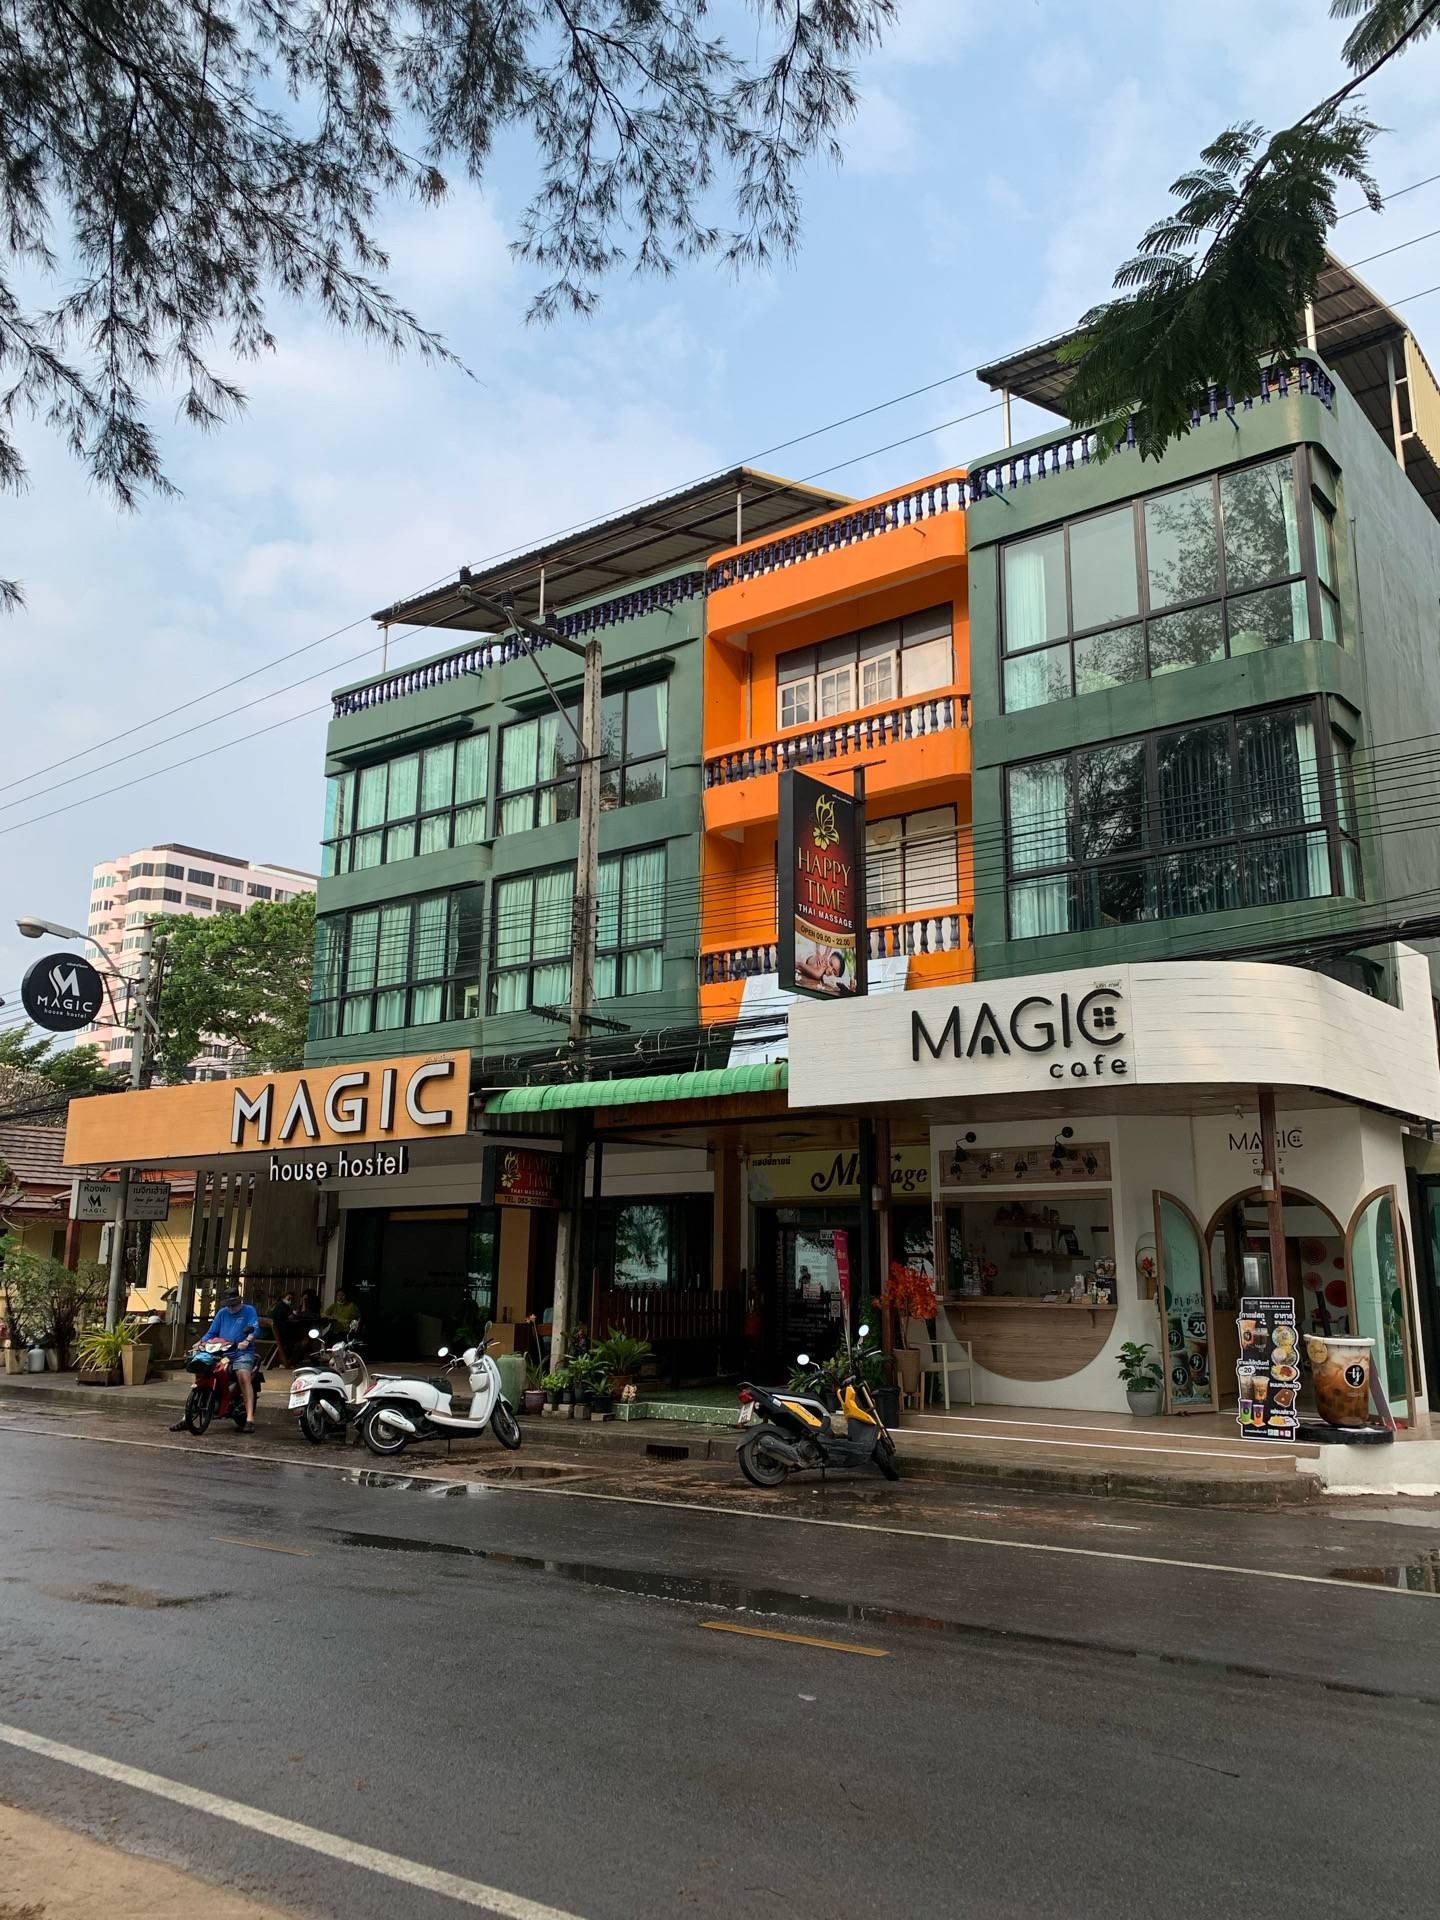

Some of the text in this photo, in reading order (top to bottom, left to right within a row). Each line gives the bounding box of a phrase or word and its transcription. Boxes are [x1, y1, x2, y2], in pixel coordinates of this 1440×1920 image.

[798, 847, 852, 888] HAPPY
[805, 878, 846, 914] TIME
[798, 903, 853, 929] THAI MASSAGE
[800, 925, 816, 937] OPEN
[816, 932, 832, 944] 09.00
[836, 937, 851, 947] 22.00
[36, 995, 93, 1013] MAGIC
[44, 1007, 88, 1019] house hostel
[911, 986, 1125, 1062] MAGIC
[1049, 1053, 1129, 1082] cafe
[230, 1061, 456, 1148] MAGIC
[1228, 1129, 1304, 1151] MAIC
[269, 1145, 409, 1182] house hostel
[811, 1152, 929, 1193] Mage
[83, 1184, 112, 1193] ห้องพัก
